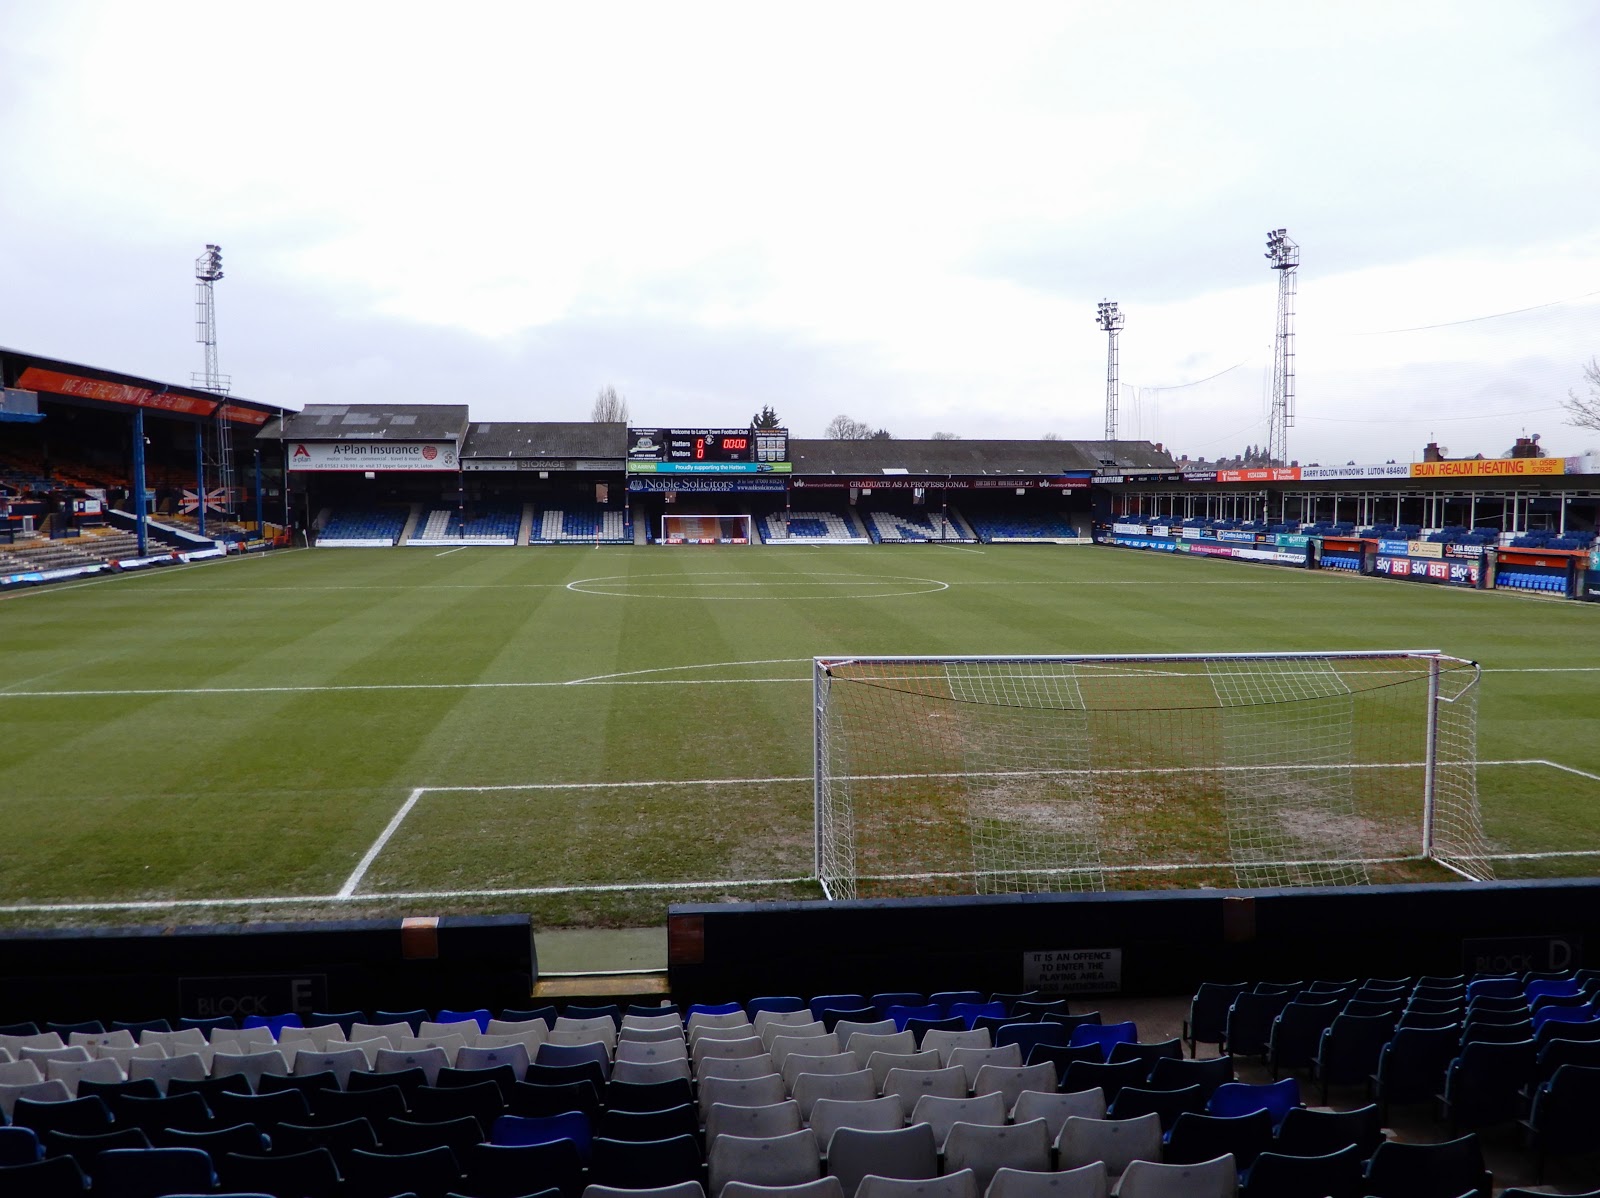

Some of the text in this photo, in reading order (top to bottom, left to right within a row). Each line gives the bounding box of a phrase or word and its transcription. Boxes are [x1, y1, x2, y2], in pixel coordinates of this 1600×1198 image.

[697, 439, 704, 448] 0
[334, 445, 420, 454] A-Plan Insurance
[697, 450, 704, 458] 0
[1339, 468, 1364, 476] WINDOWS
[1368, 468, 1384, 476] LUTON
[1386, 466, 1408, 475] 484600
[1415, 464, 1434, 476] SUN
[1439, 462, 1472, 474] REALM
[1478, 460, 1524, 474] HEATING
[644, 478, 680, 488] Noble
[682, 478, 734, 488] Solicitors
[1376, 558, 1408, 574] sky BET
[1412, 561, 1446, 578] sky BET
[1451, 564, 1468, 581] sky
[1073, 952, 1111, 960] OFFENCE
[1476, 940, 1572, 972] BLOCK D
[1056, 963, 1084, 971] ENTER
[1040, 974, 1076, 982] PLAYING
[198, 979, 312, 1016] BLOCK E
